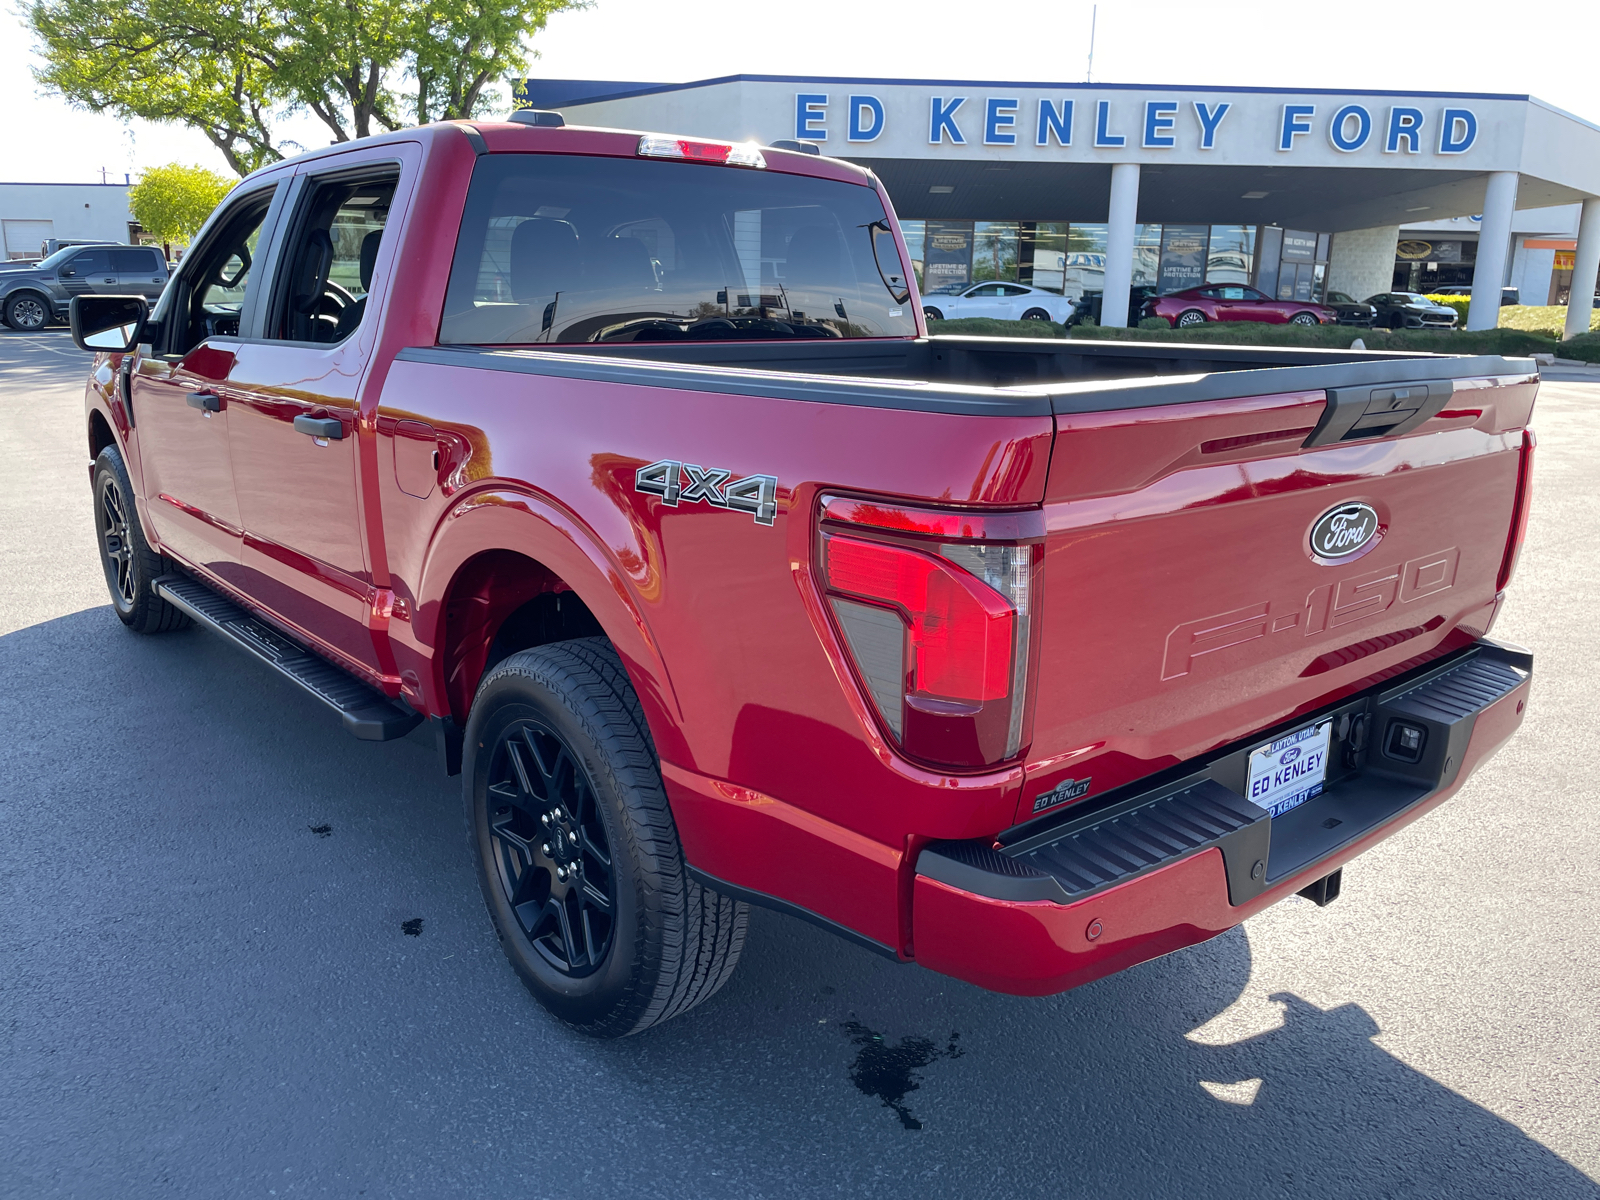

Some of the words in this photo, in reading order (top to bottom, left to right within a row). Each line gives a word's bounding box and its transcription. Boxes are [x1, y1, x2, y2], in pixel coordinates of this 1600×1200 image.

[795, 94, 885, 143] ED
[928, 96, 1232, 150] KENLEY
[1278, 104, 1479, 155] FORD
[1323, 512, 1369, 550] Ford
[1161, 546, 1461, 682] F-150
[1299, 726, 1315, 741] UTAH
[1252, 775, 1270, 798] ED
[1274, 751, 1324, 788] KENLEY
[1033, 796, 1049, 810] ED
[1050, 782, 1090, 804] KENLEY
[1277, 789, 1310, 814] KENLEY
